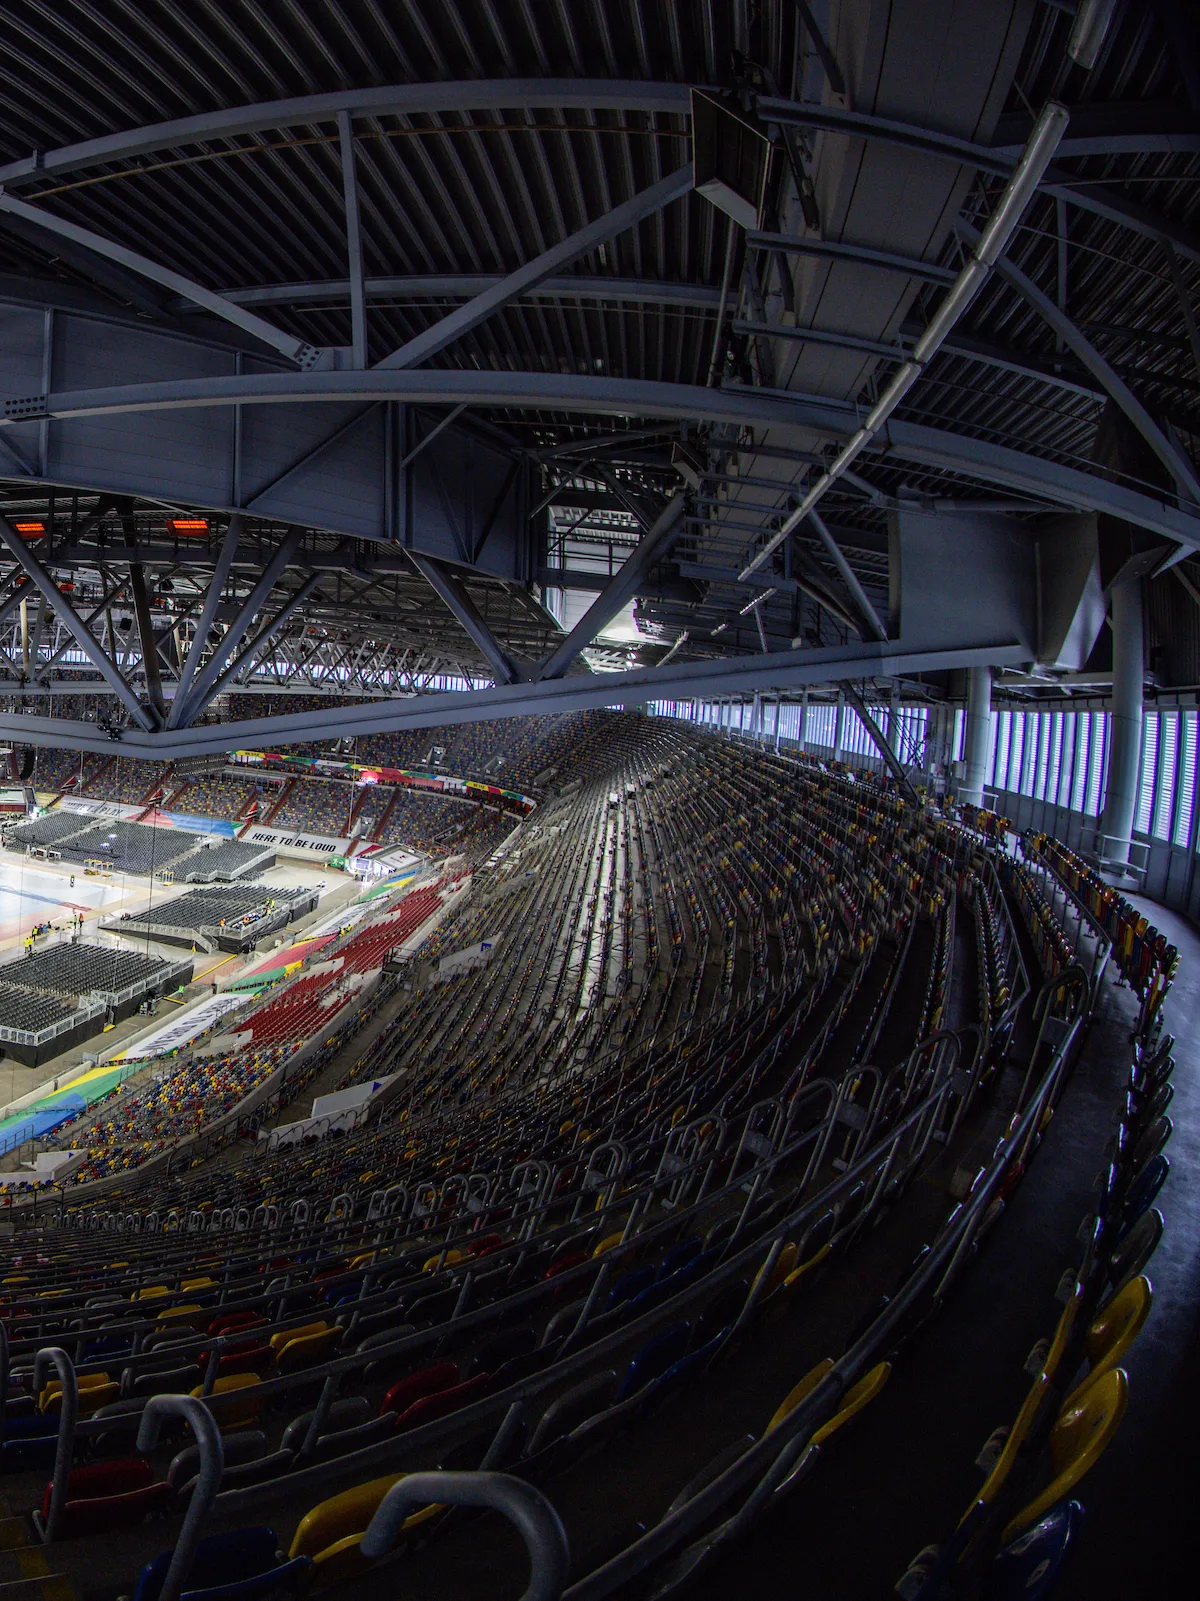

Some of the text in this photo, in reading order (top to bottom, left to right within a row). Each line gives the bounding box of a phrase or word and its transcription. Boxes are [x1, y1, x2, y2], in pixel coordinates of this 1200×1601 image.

[98, 806, 124, 817] PLAY
[251, 832, 337, 853] HERE TO BE LOUD
